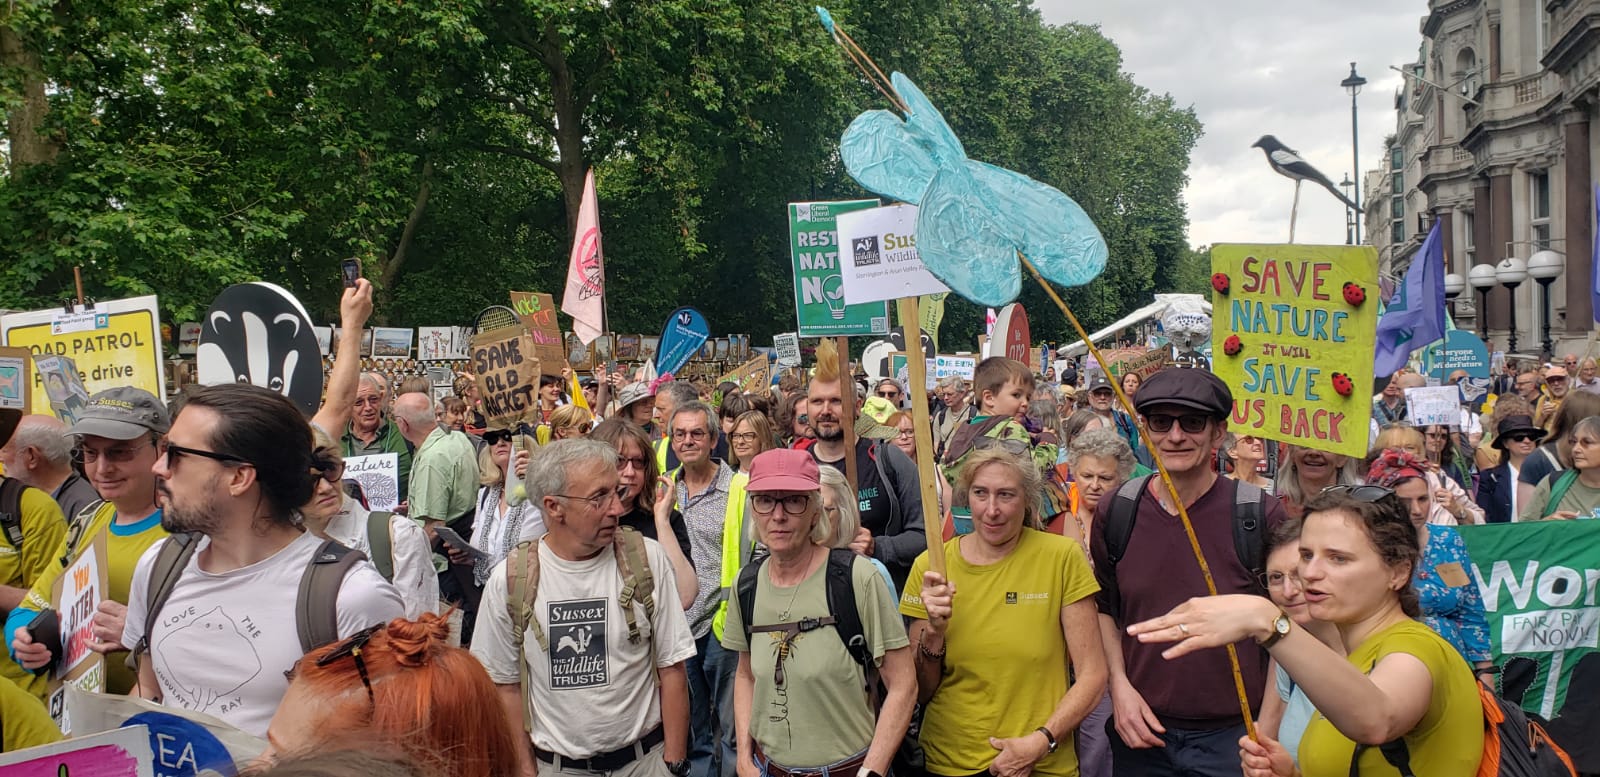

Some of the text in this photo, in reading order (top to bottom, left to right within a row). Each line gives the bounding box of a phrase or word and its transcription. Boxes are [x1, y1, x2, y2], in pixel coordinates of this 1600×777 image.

[797, 230, 838, 247] REST
[883, 232, 916, 251] Sus
[799, 251, 840, 270] NAT
[885, 249, 920, 263] Wildli
[1242, 256, 1332, 301] SAVE
[1231, 299, 1349, 343] NATURE
[26, 331, 144, 357] OAD PATROL
[1262, 342, 1311, 359] IT WILL
[475, 337, 524, 375] SAME
[91, 364, 134, 382] drive
[485, 369, 519, 394] OLD
[1243, 358, 1321, 401] SAVE
[1231, 399, 1345, 443] US BACK
[858, 487, 879, 500] ANGE
[163, 606, 262, 639] LOVE THE
[551, 606, 605, 622] Sussex
[1512, 612, 1585, 630] FAIR PAY
[552, 653, 605, 675] wildlife
[553, 672, 606, 686] TRUSTS
[220, 696, 244, 714] RAY
[157, 733, 200, 775] EA
